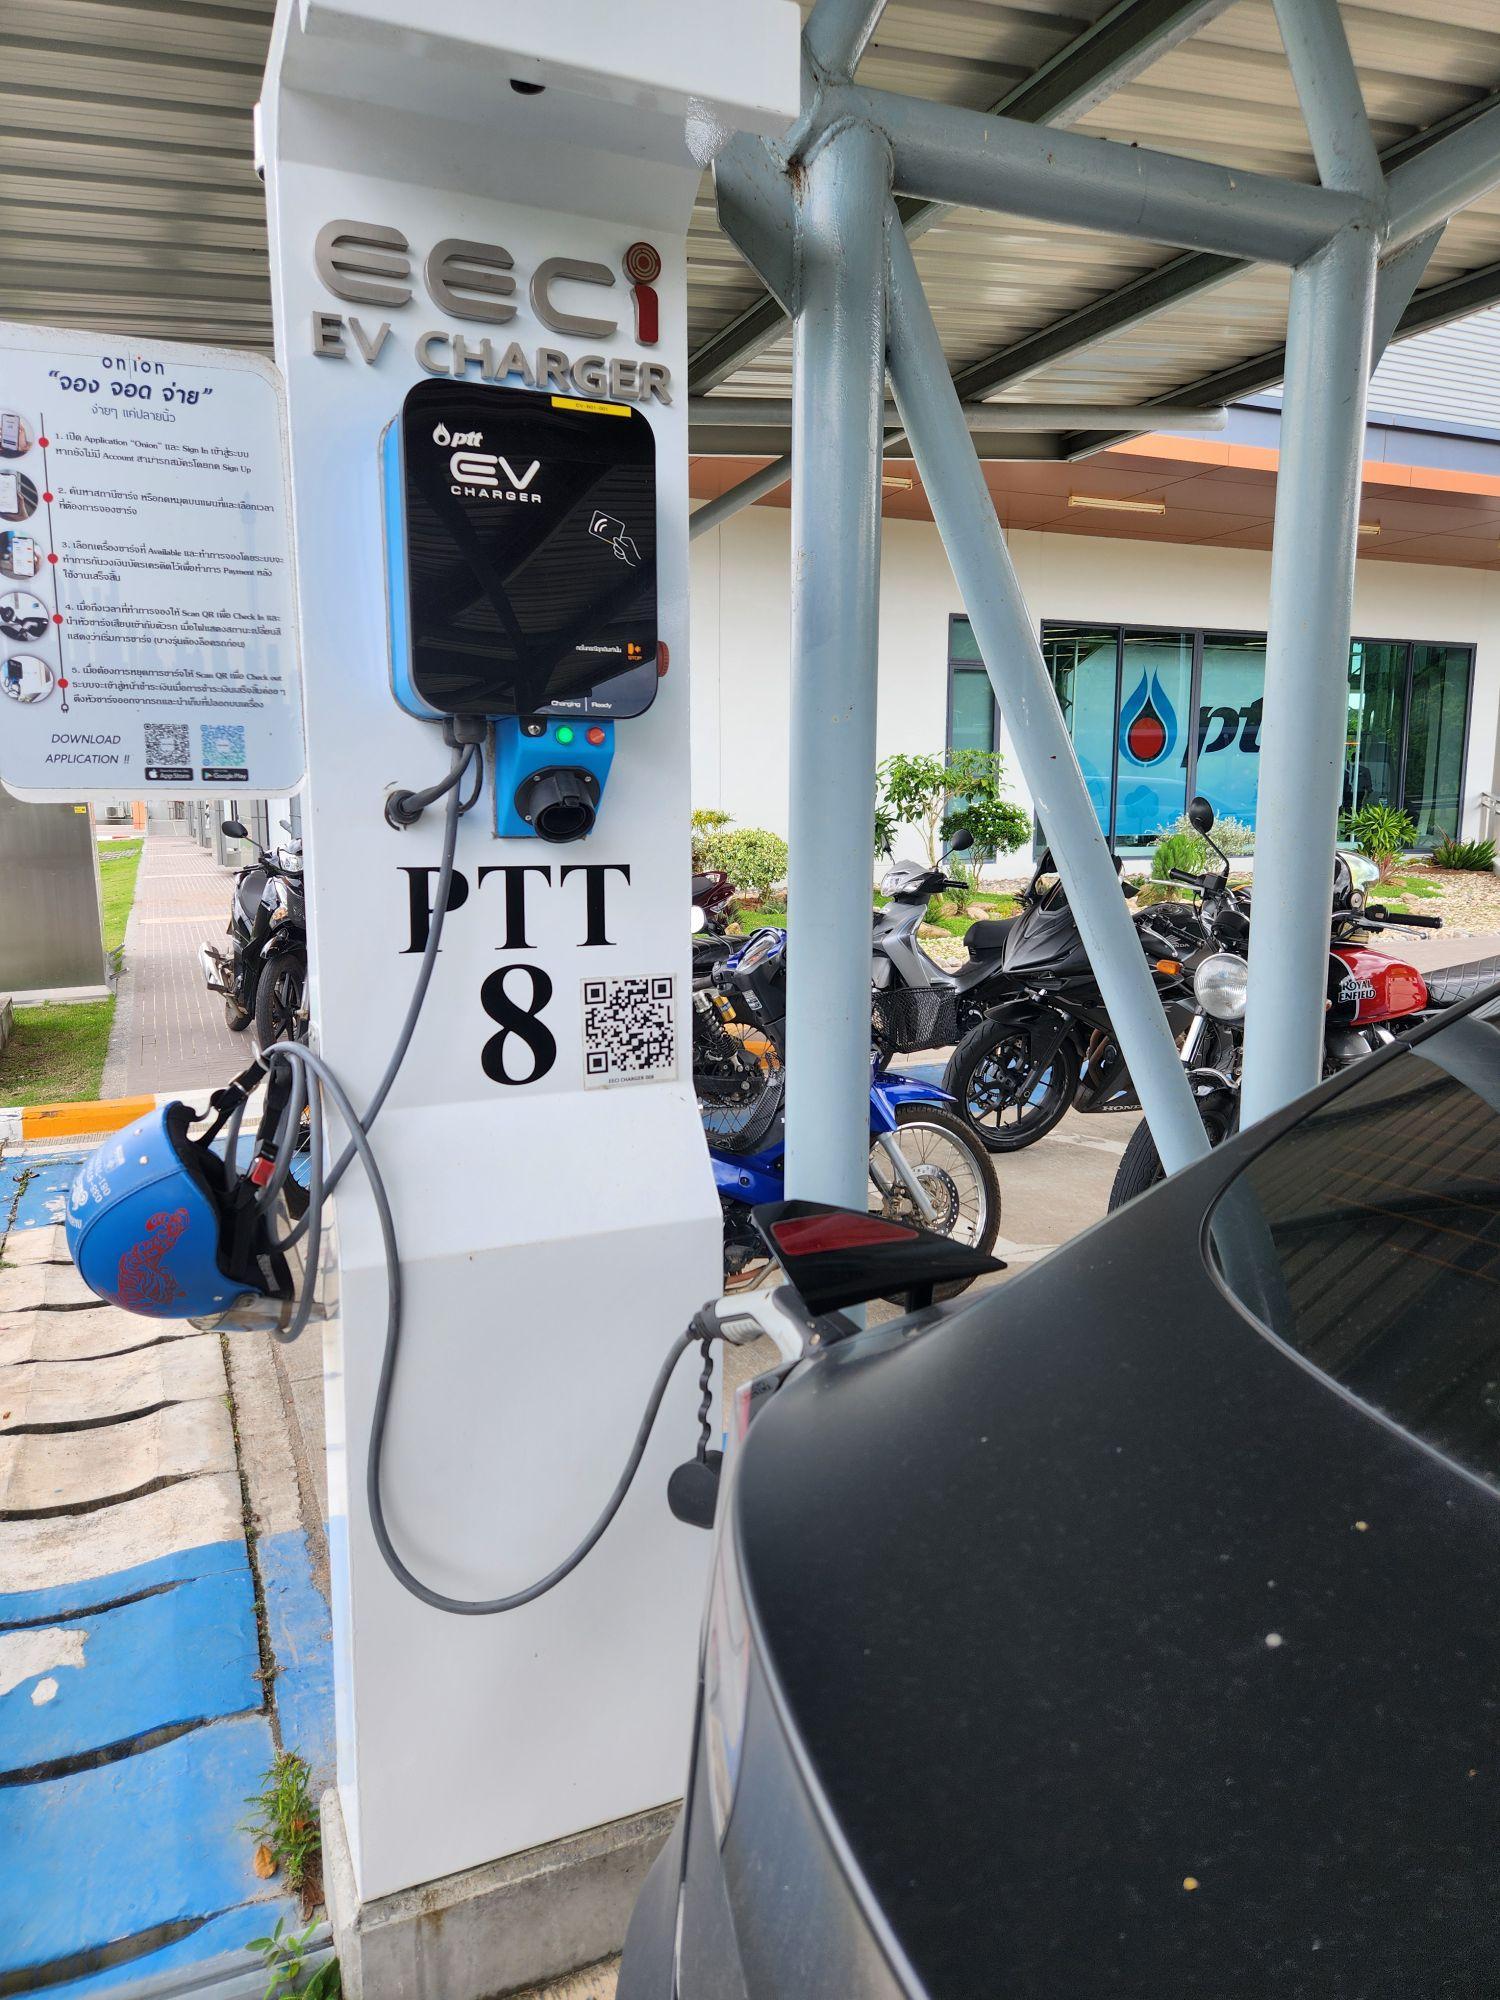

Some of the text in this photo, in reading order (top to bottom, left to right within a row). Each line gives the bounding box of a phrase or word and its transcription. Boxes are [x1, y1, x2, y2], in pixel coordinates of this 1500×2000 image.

[312, 310, 673, 405] EV CHARGER
[110, 381, 152, 400] จอด
[123, 407, 176, 422] แค่ปลายนิ้ว
[66, 431, 82, 442] เปิด
[84, 435, 128, 446] Application
[165, 443, 180, 451] และ
[182, 445, 199, 454] Sign
[211, 446, 249, 458] เข้าสู่ระบบ
[450, 430, 484, 448] ptt
[55, 447, 101, 459] หากยังไม่มี
[103, 452, 135, 462] Account
[222, 464, 239, 472] Sign
[241, 465, 251, 474] Up
[449, 451, 540, 490] EV
[450, 485, 542, 503] CHARGER
[148, 548, 182, 557] Available
[223, 567, 254, 576] Payment
[201, 611, 214, 619] QR
[233, 612, 256, 620] Check
[215, 672, 228, 680] QR
[246, 673, 269, 681] Check
[550, 699, 581, 709] Charging
[591, 701, 612, 709] Ready
[51, 733, 121, 745] DOWNLOAD
[1180, 697, 1263, 768] pt
[45, 753, 119, 764] APPLICATION
[396, 864, 631, 954] PTT
[1342, 979, 1372, 990] ROYAL
[1340, 990, 1376, 1001] ENFIELD
[480, 963, 557, 1086] 8
